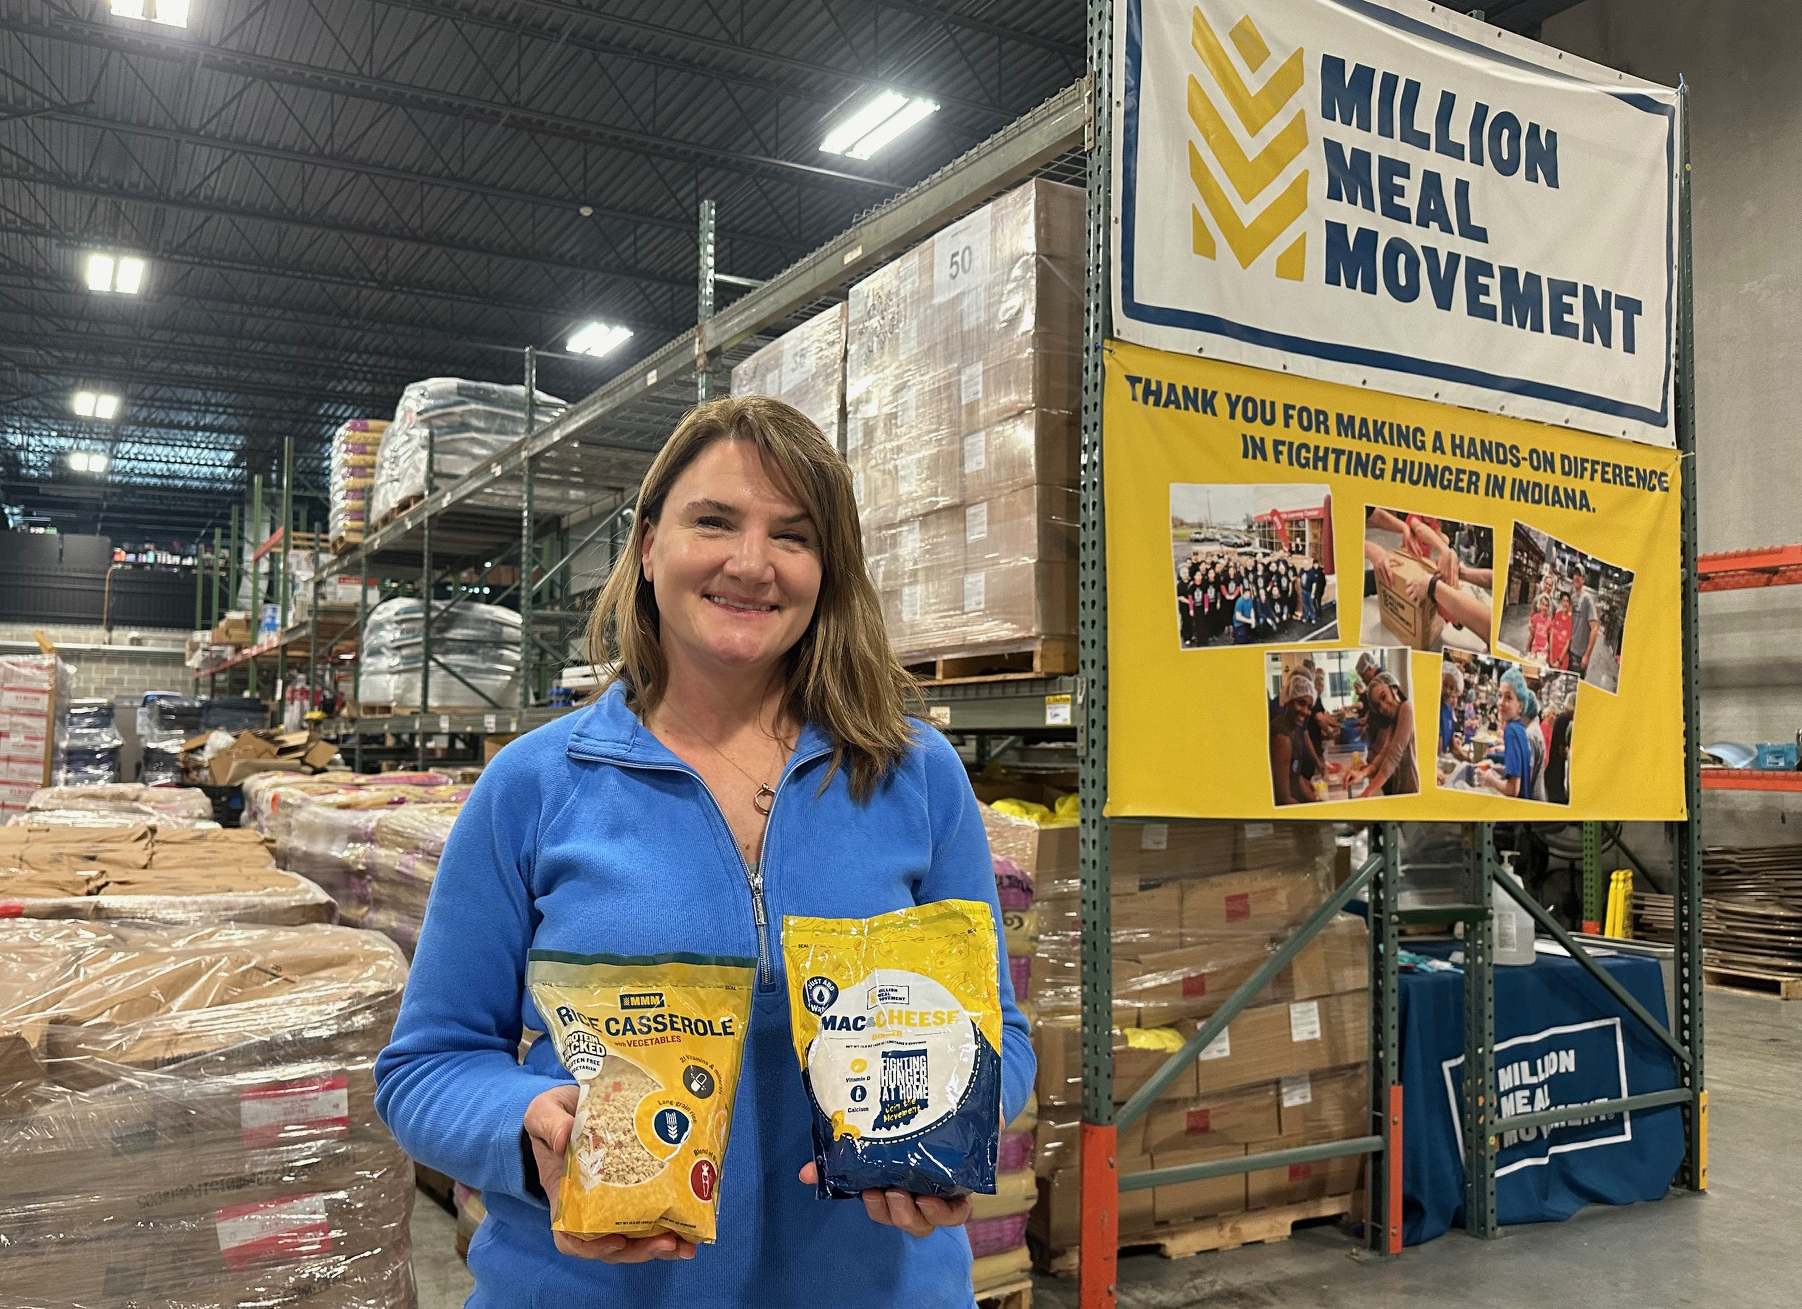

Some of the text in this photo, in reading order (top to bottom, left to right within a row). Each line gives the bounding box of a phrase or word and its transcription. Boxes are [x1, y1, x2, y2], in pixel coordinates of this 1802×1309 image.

[1321, 54, 1559, 189] MILLION
[1323, 137, 1489, 244] MEAL
[949, 245, 972, 280] 50
[1325, 219, 1642, 355] MOVEMENT
[1124, 374, 1670, 493] THANK YOU FOR MAKING A HANDS-ON DIFFERENCE
[1240, 433, 1597, 513] IN FIGHTING HUNGER IN INDIANA.
[808, 978, 835, 991] JUST ADD
[630, 994, 661, 1007] MMM
[556, 1006, 735, 1036] RICE CASSEROLE
[821, 1014, 867, 1031] MAC
[875, 1009, 960, 1028] CHEESE
[565, 1030, 600, 1045] ROTEIN
[614, 1035, 682, 1048] with VEGETABLES
[871, 1030, 903, 1041] DINNER
[586, 1057, 600, 1067] FREE
[880, 1055, 927, 1071] FIGHTING
[1498, 1049, 1575, 1092] MILLION
[881, 1070, 928, 1088] HUNGER
[881, 1084, 929, 1102] AT HOME
[883, 1105, 922, 1123] Movement
[885, 1099, 916, 1114] Join the
[690, 1110, 698, 1124] rice
[693, 1147, 708, 1157] Blend
